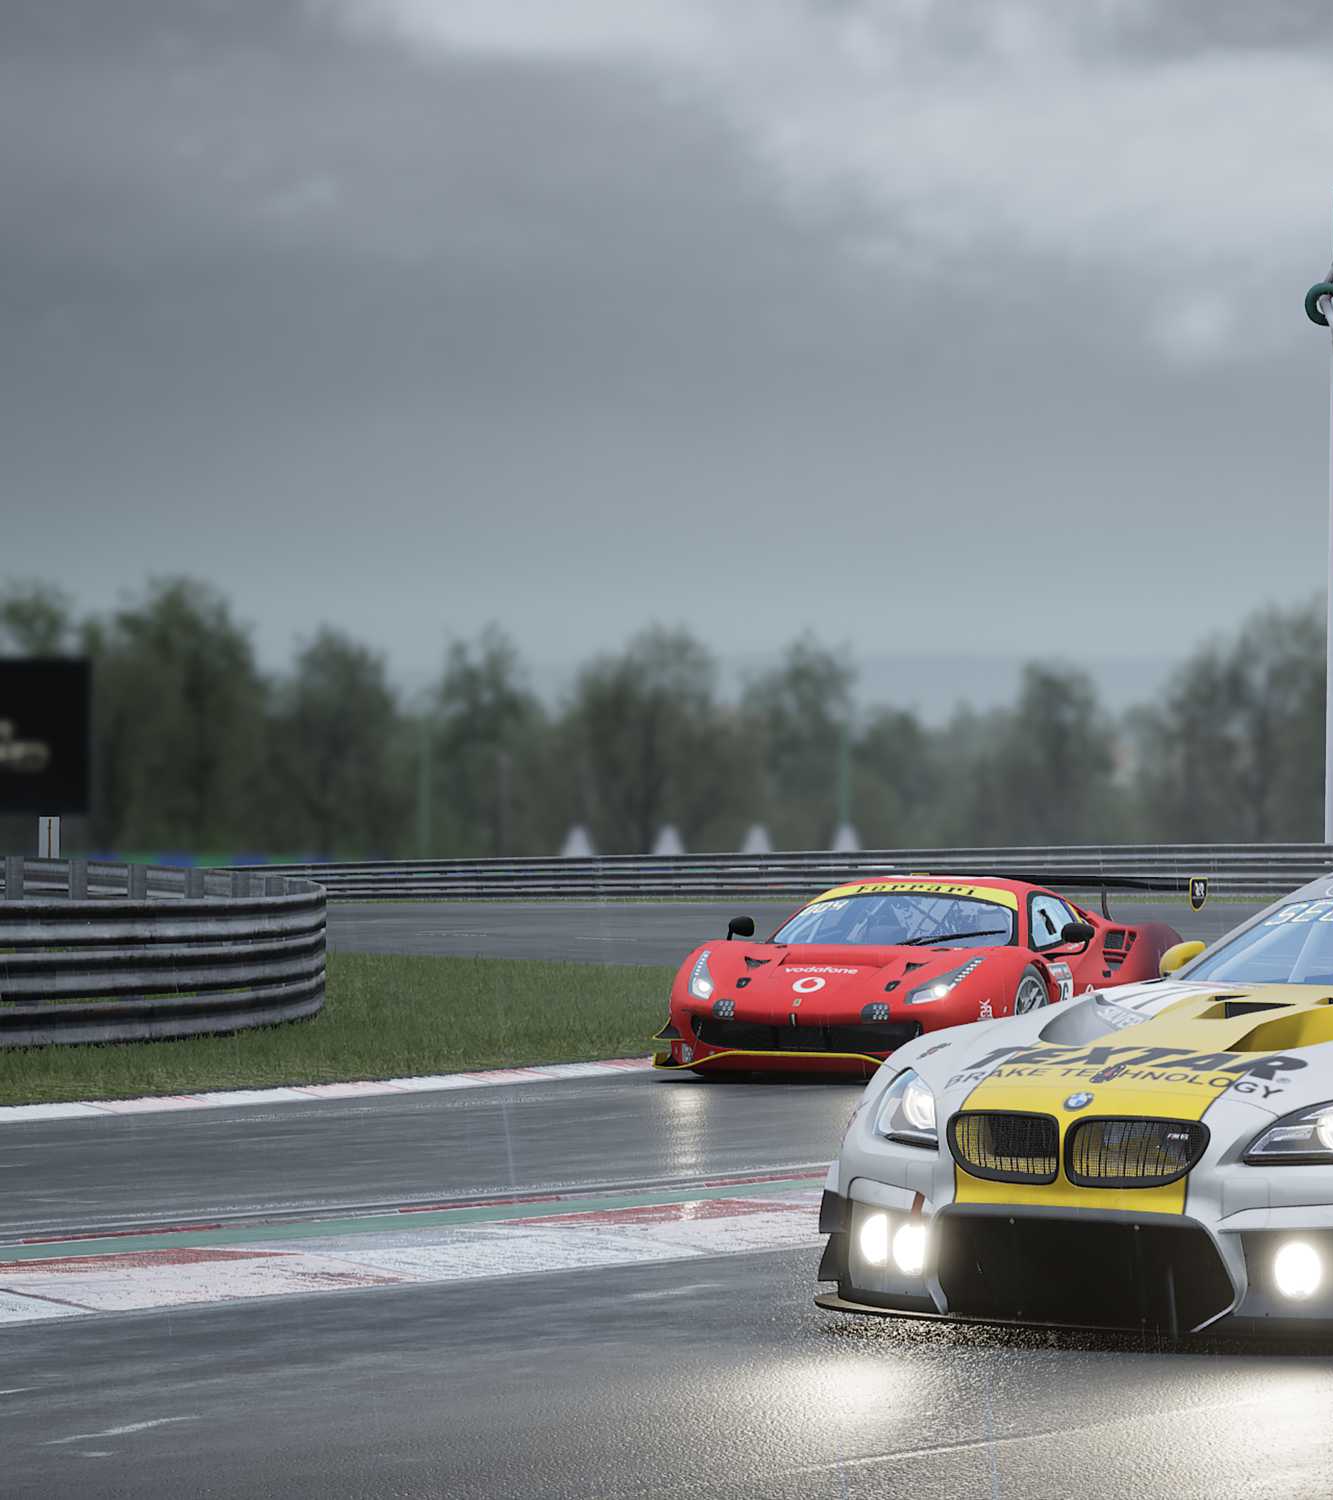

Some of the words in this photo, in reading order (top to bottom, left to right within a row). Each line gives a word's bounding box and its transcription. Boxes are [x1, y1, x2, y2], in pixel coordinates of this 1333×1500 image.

[856, 884, 975, 896] Ferrari
[784, 965, 859, 976] vodafone
[962, 1046, 1309, 1082] TEXTAR
[944, 1066, 1055, 1090] BRAKE
[1060, 1066, 1286, 1100] TEHNOLOGY
